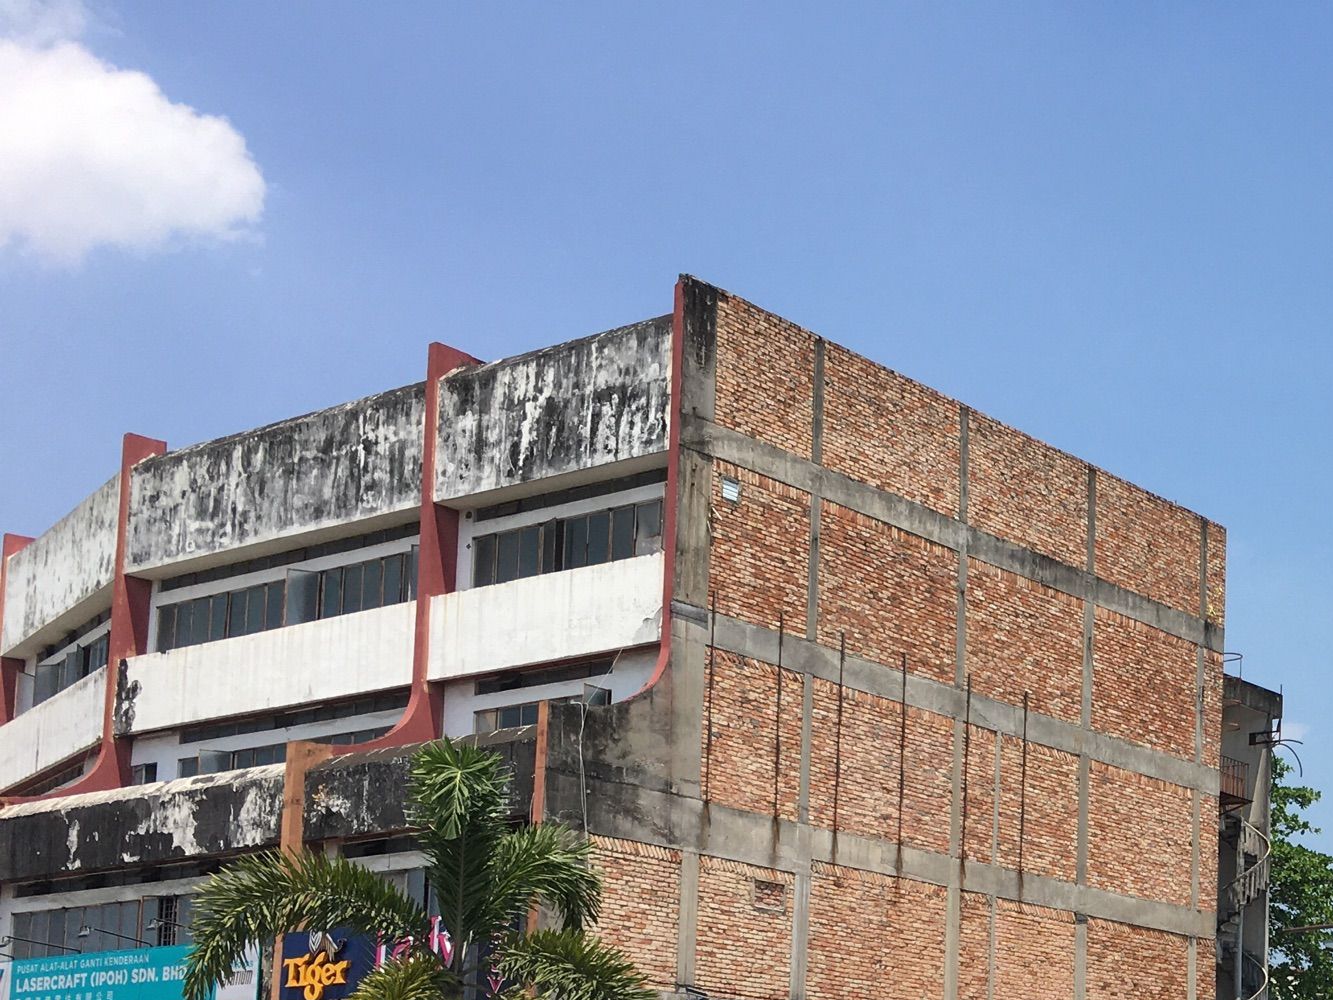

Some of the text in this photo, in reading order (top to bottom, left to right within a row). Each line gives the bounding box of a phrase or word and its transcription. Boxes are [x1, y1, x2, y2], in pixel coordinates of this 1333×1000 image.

[17, 954, 150, 974] PUSAT ALAT-ALAT GANTI KENDERAAN
[16, 972, 88, 993] LASERCRAFT
[90, 969, 128, 988] (IPOH)
[131, 967, 158, 984] SDN.
